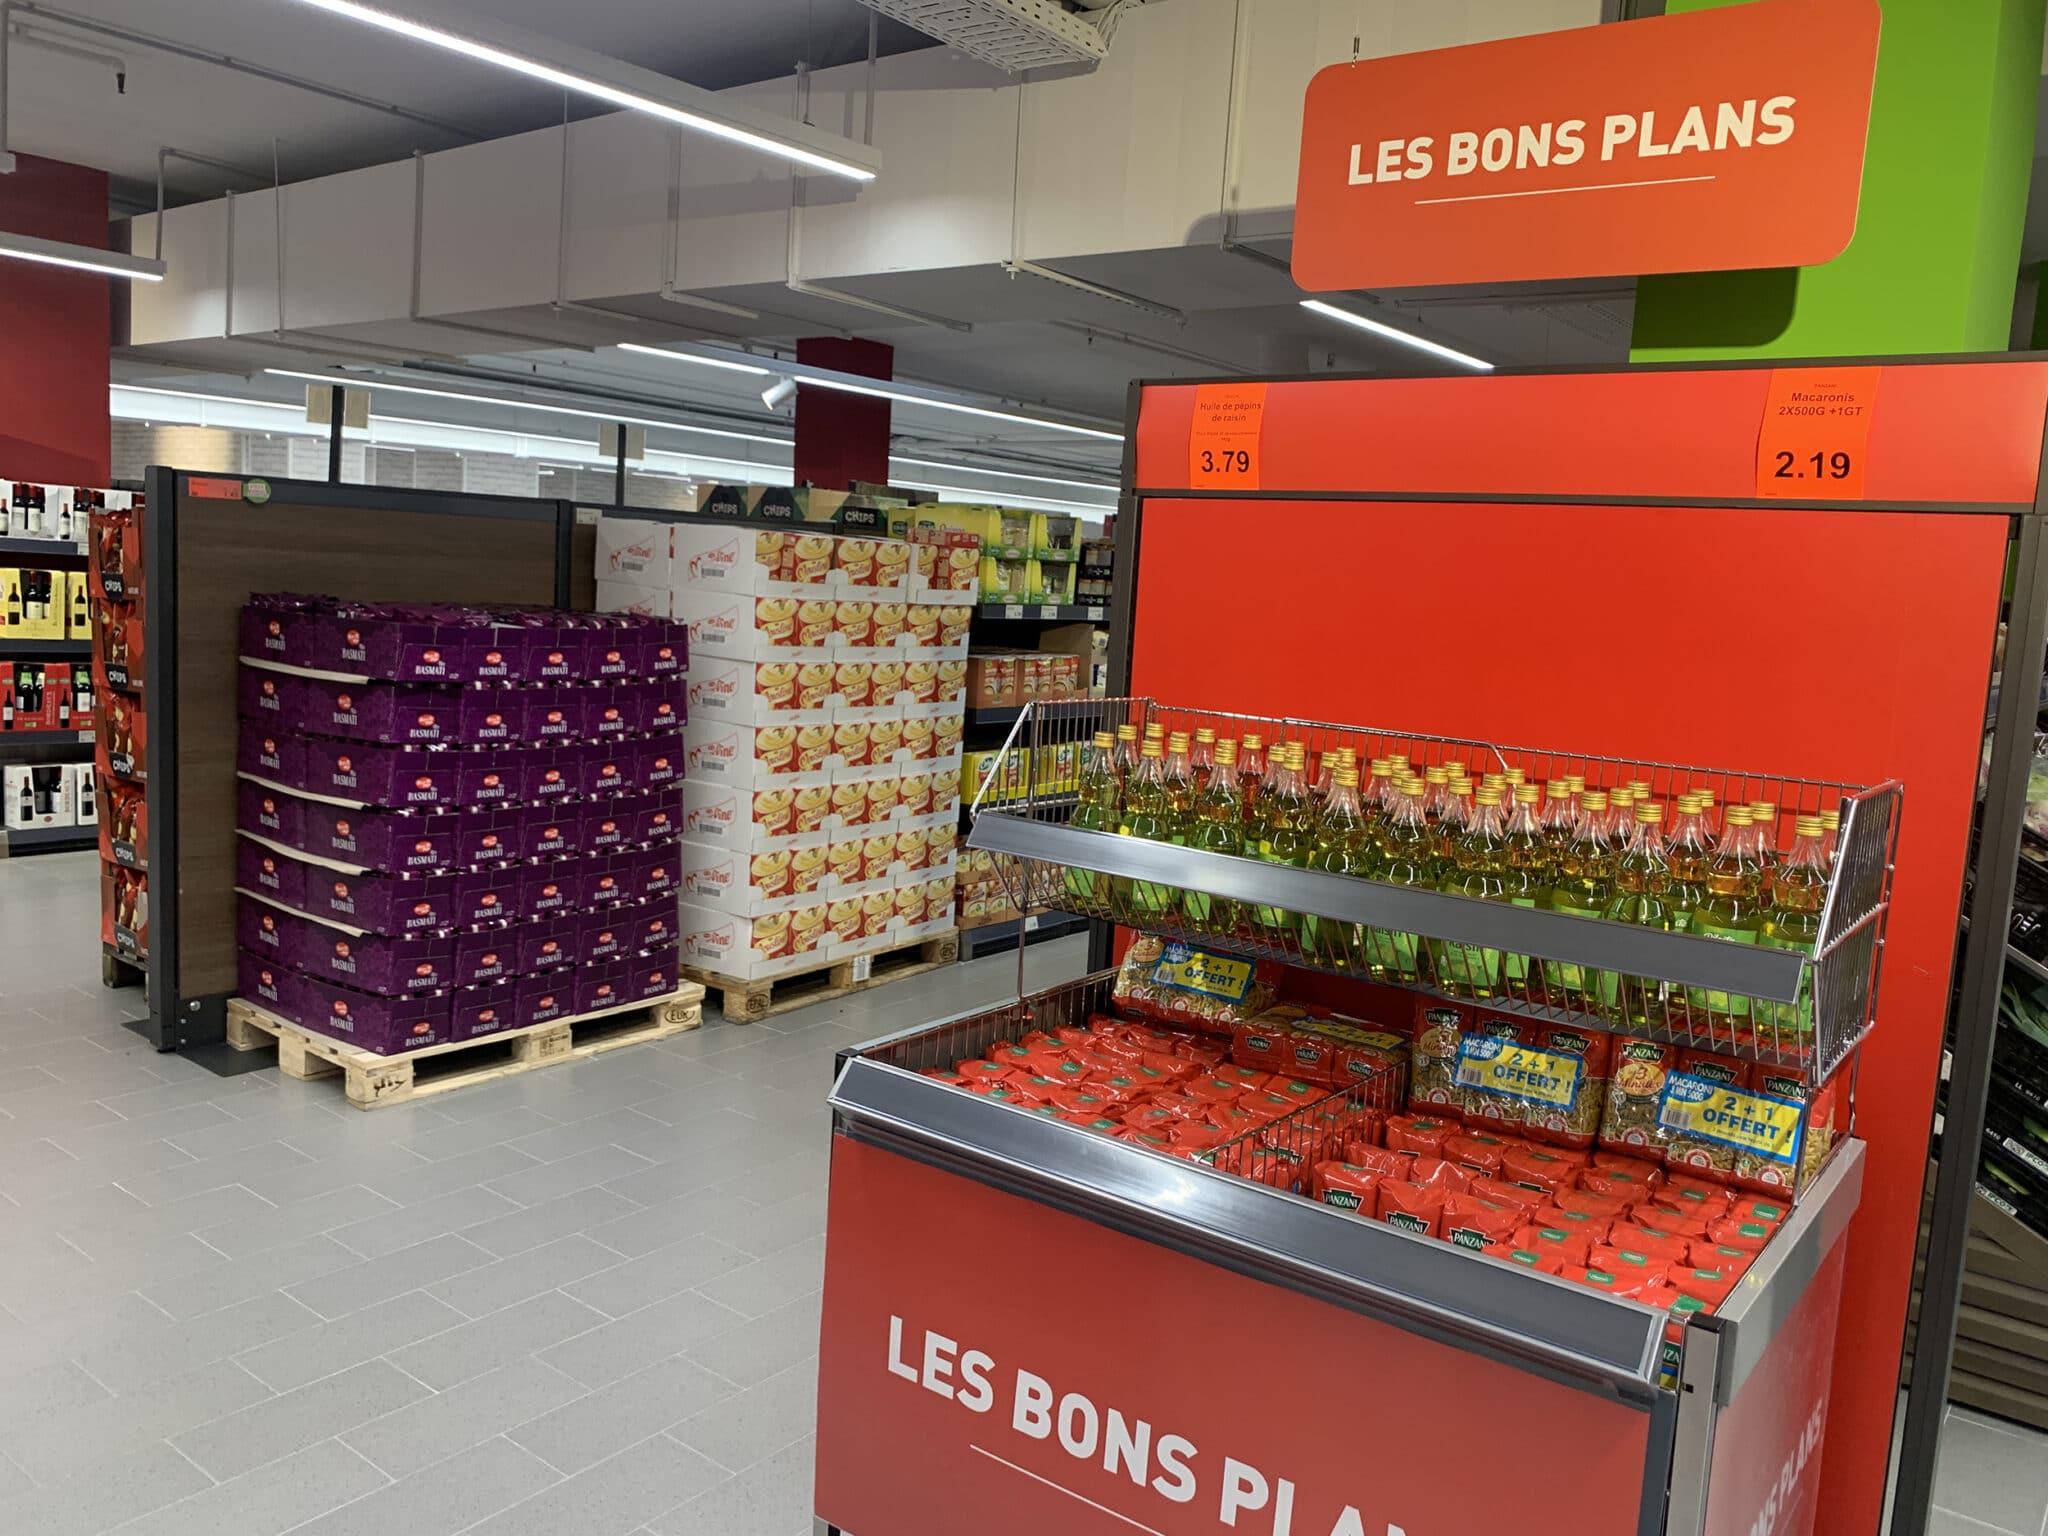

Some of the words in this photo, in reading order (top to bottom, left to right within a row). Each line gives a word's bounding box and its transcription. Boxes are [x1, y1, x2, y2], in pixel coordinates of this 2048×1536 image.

[1348, 137, 1434, 187] LES
[1446, 119, 1586, 178] BONS
[1600, 95, 1797, 161] PLANS
[1791, 392, 1855, 402] Macaronis
[1200, 402, 1220, 410] Huile
[1222, 402, 1233, 410] de
[1234, 402, 1261, 412] pépins
[1779, 406, 1825, 416] 2X500G
[1829, 406, 1863, 416] +1GT
[1201, 450, 1250, 473] 3.79
[1774, 451, 1851, 479] 2.19
[711, 502, 739, 515] CHIPS
[763, 504, 791, 518] CHIPS
[845, 511, 875, 524] CHIPS
[342, 648, 366, 661] BASMATI
[415, 665, 446, 676] BASMATI
[479, 666, 507, 676] BASMATI
[542, 666, 568, 676] BASMATI
[601, 664, 626, 674] BASMATI
[654, 660, 677, 670] BASMATI
[333, 711, 358, 726] BASMATI
[653, 716, 676, 726] BASMATI
[479, 727, 507, 737] BASMATI
[541, 725, 567, 734] BASMATI
[599, 721, 624, 731] BASMATI
[409, 728, 440, 738] BASMATI
[332, 773, 357, 788] BASMATI
[649, 770, 673, 780] BASMATI
[539, 783, 565, 794] BASMATI
[597, 777, 622, 788] BASMATI
[407, 791, 438, 801] BASMATI
[476, 788, 505, 799] BASMATI
[648, 825, 672, 836] BASMATI
[332, 837, 356, 852] BASMATI
[595, 834, 620, 844] BASMATI
[537, 841, 564, 851] BASMATI
[407, 855, 437, 865] BASMATI
[475, 848, 503, 859] BASMATI
[646, 877, 670, 891] BASMATI
[594, 888, 619, 900] BASMATI
[330, 899, 355, 914] BASMATI
[536, 895, 563, 909] BASMATI
[474, 906, 502, 918] BASMATI
[406, 916, 436, 928] BASMATI
[644, 931, 668, 944] BASMATI
[593, 942, 618, 955] BASMATI
[536, 952, 562, 965] BASMATI
[1201, 958, 1209, 967] 2
[331, 958, 356, 974] BASMATI
[474, 965, 502, 978] BASMATI
[407, 976, 438, 988] BASMATI
[1184, 967, 1236, 988] OFFERT
[644, 982, 667, 995] BASMATI
[591, 994, 616, 1008] BASMATI
[532, 1007, 559, 1021] BASMATI
[329, 1016, 354, 1032] BASMATI
[472, 1022, 499, 1034] BASMATI
[405, 1033, 435, 1047] BASMATI
[1625, 1046, 1660, 1060] PANZANI
[1512, 1052, 1523, 1066] 2
[1530, 1061, 1539, 1069] +
[1547, 1060, 1554, 1072] 1
[1493, 1064, 1561, 1091] OFFERT
[1635, 1067, 1648, 1080] 3
[1695, 1067, 1731, 1083] PANZANI
[1669, 1075, 1715, 1094] MACARONI
[1767, 1081, 1805, 1098] PANZANI
[1724, 1097, 1737, 1111] 2
[1744, 1105, 1755, 1116] +
[1765, 1107, 1773, 1121] 1
[1703, 1108, 1780, 1140] OFFERT
[1785, 1129, 1792, 1143] !
[2025, 1152, 2044, 1167] IFCO
[1325, 1193, 1359, 1208] PANZANI
[1988, 1191, 2007, 1208] IFCO
[1389, 1214, 1424, 1233] PANZANI
[1454, 1232, 1490, 1249] PANZAN
[888, 1315, 995, 1413] LES
[1012, 1369, 1198, 1503] BONS
[1779, 1398, 1822, 1514] PLANS
